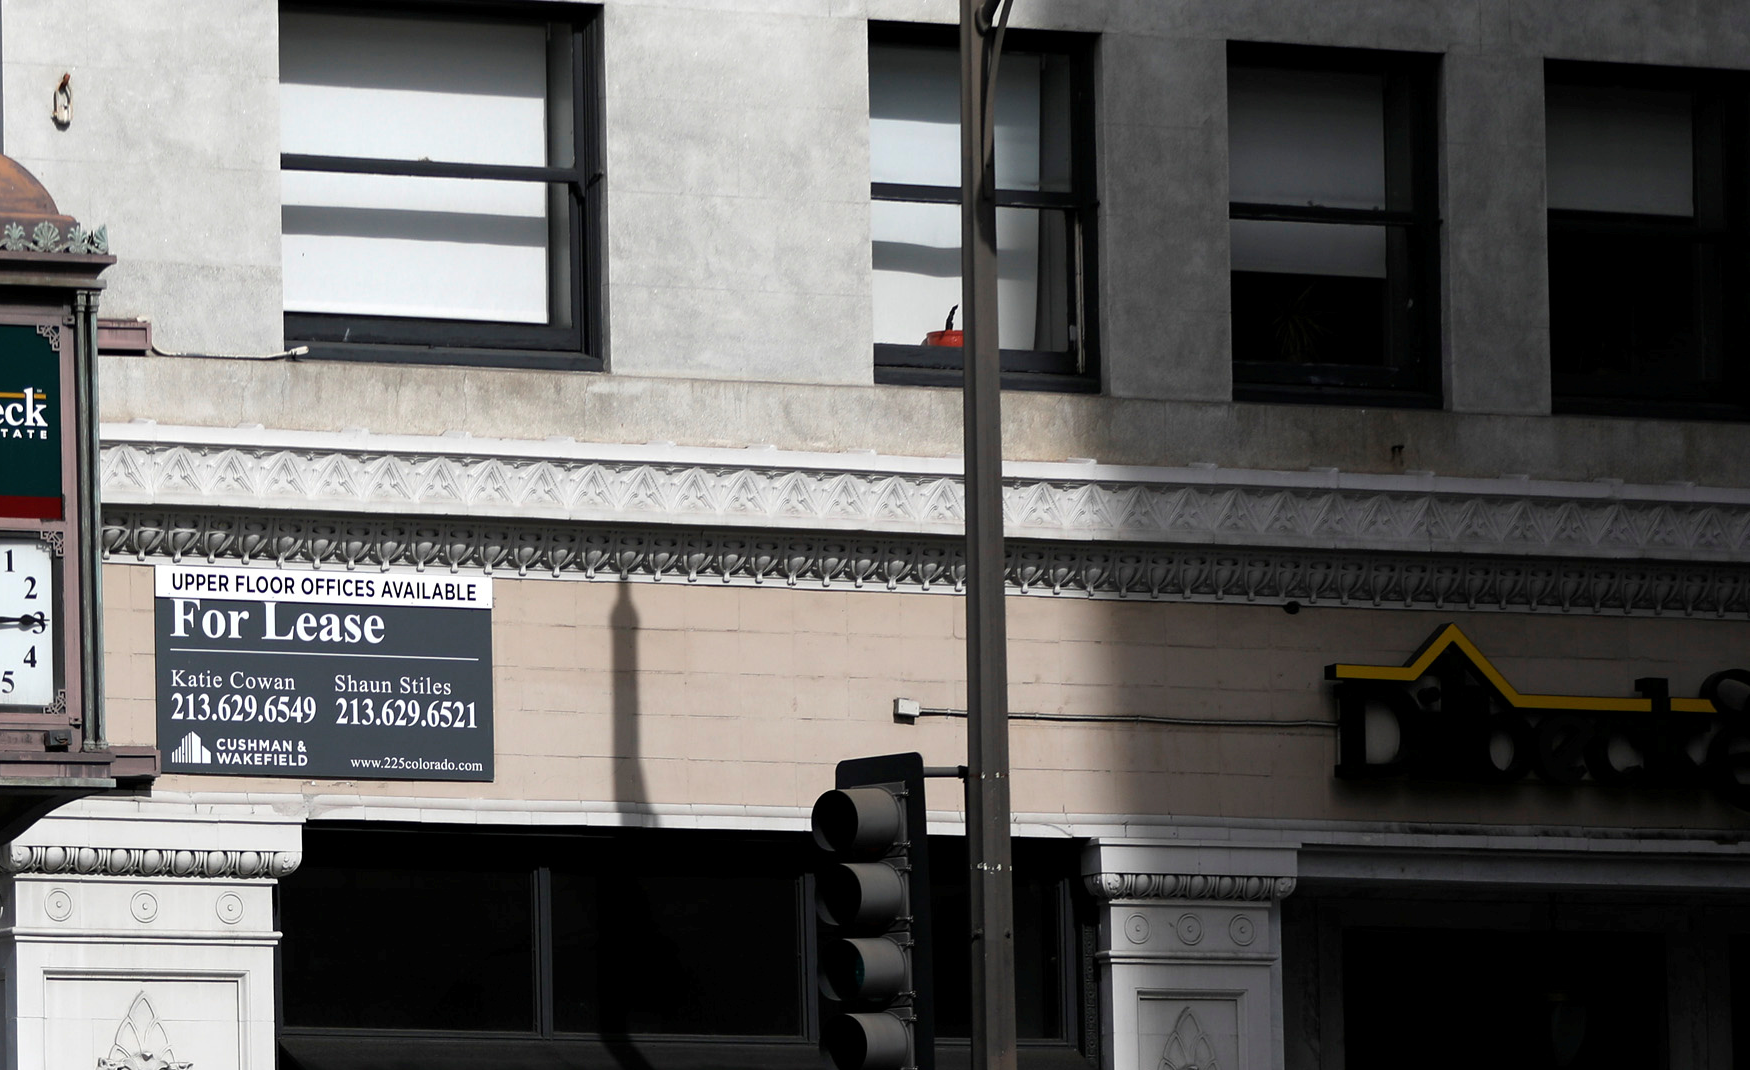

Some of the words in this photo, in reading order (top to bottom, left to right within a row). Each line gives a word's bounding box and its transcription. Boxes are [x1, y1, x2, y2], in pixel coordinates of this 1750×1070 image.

[4, 549, 15, 572] 1
[24, 576, 38, 599] 2
[171, 573, 229, 593] UPPER
[235, 575, 295, 595] FLOOR
[301, 577, 375, 598] OFFICES
[381, 580, 477, 601] AVAILABLE
[170, 598, 250, 639] For
[261, 602, 386, 644] Lease
[23, 645, 37, 668] 4
[1, 670, 15, 694] 5
[170, 669, 223, 689] Katie
[229, 671, 296, 691] Cowan
[334, 674, 393, 694] Shaun
[400, 676, 452, 695] Stiles
[170, 692, 317, 724] 213.629.6549
[335, 698, 478, 729] 213.629.6521
[216, 738, 294, 752] CUSHMAN
[297, 740, 307, 753] &
[216, 752, 308, 767] WAKEFIELD
[350, 757, 483, 772] www.225colorado.com
